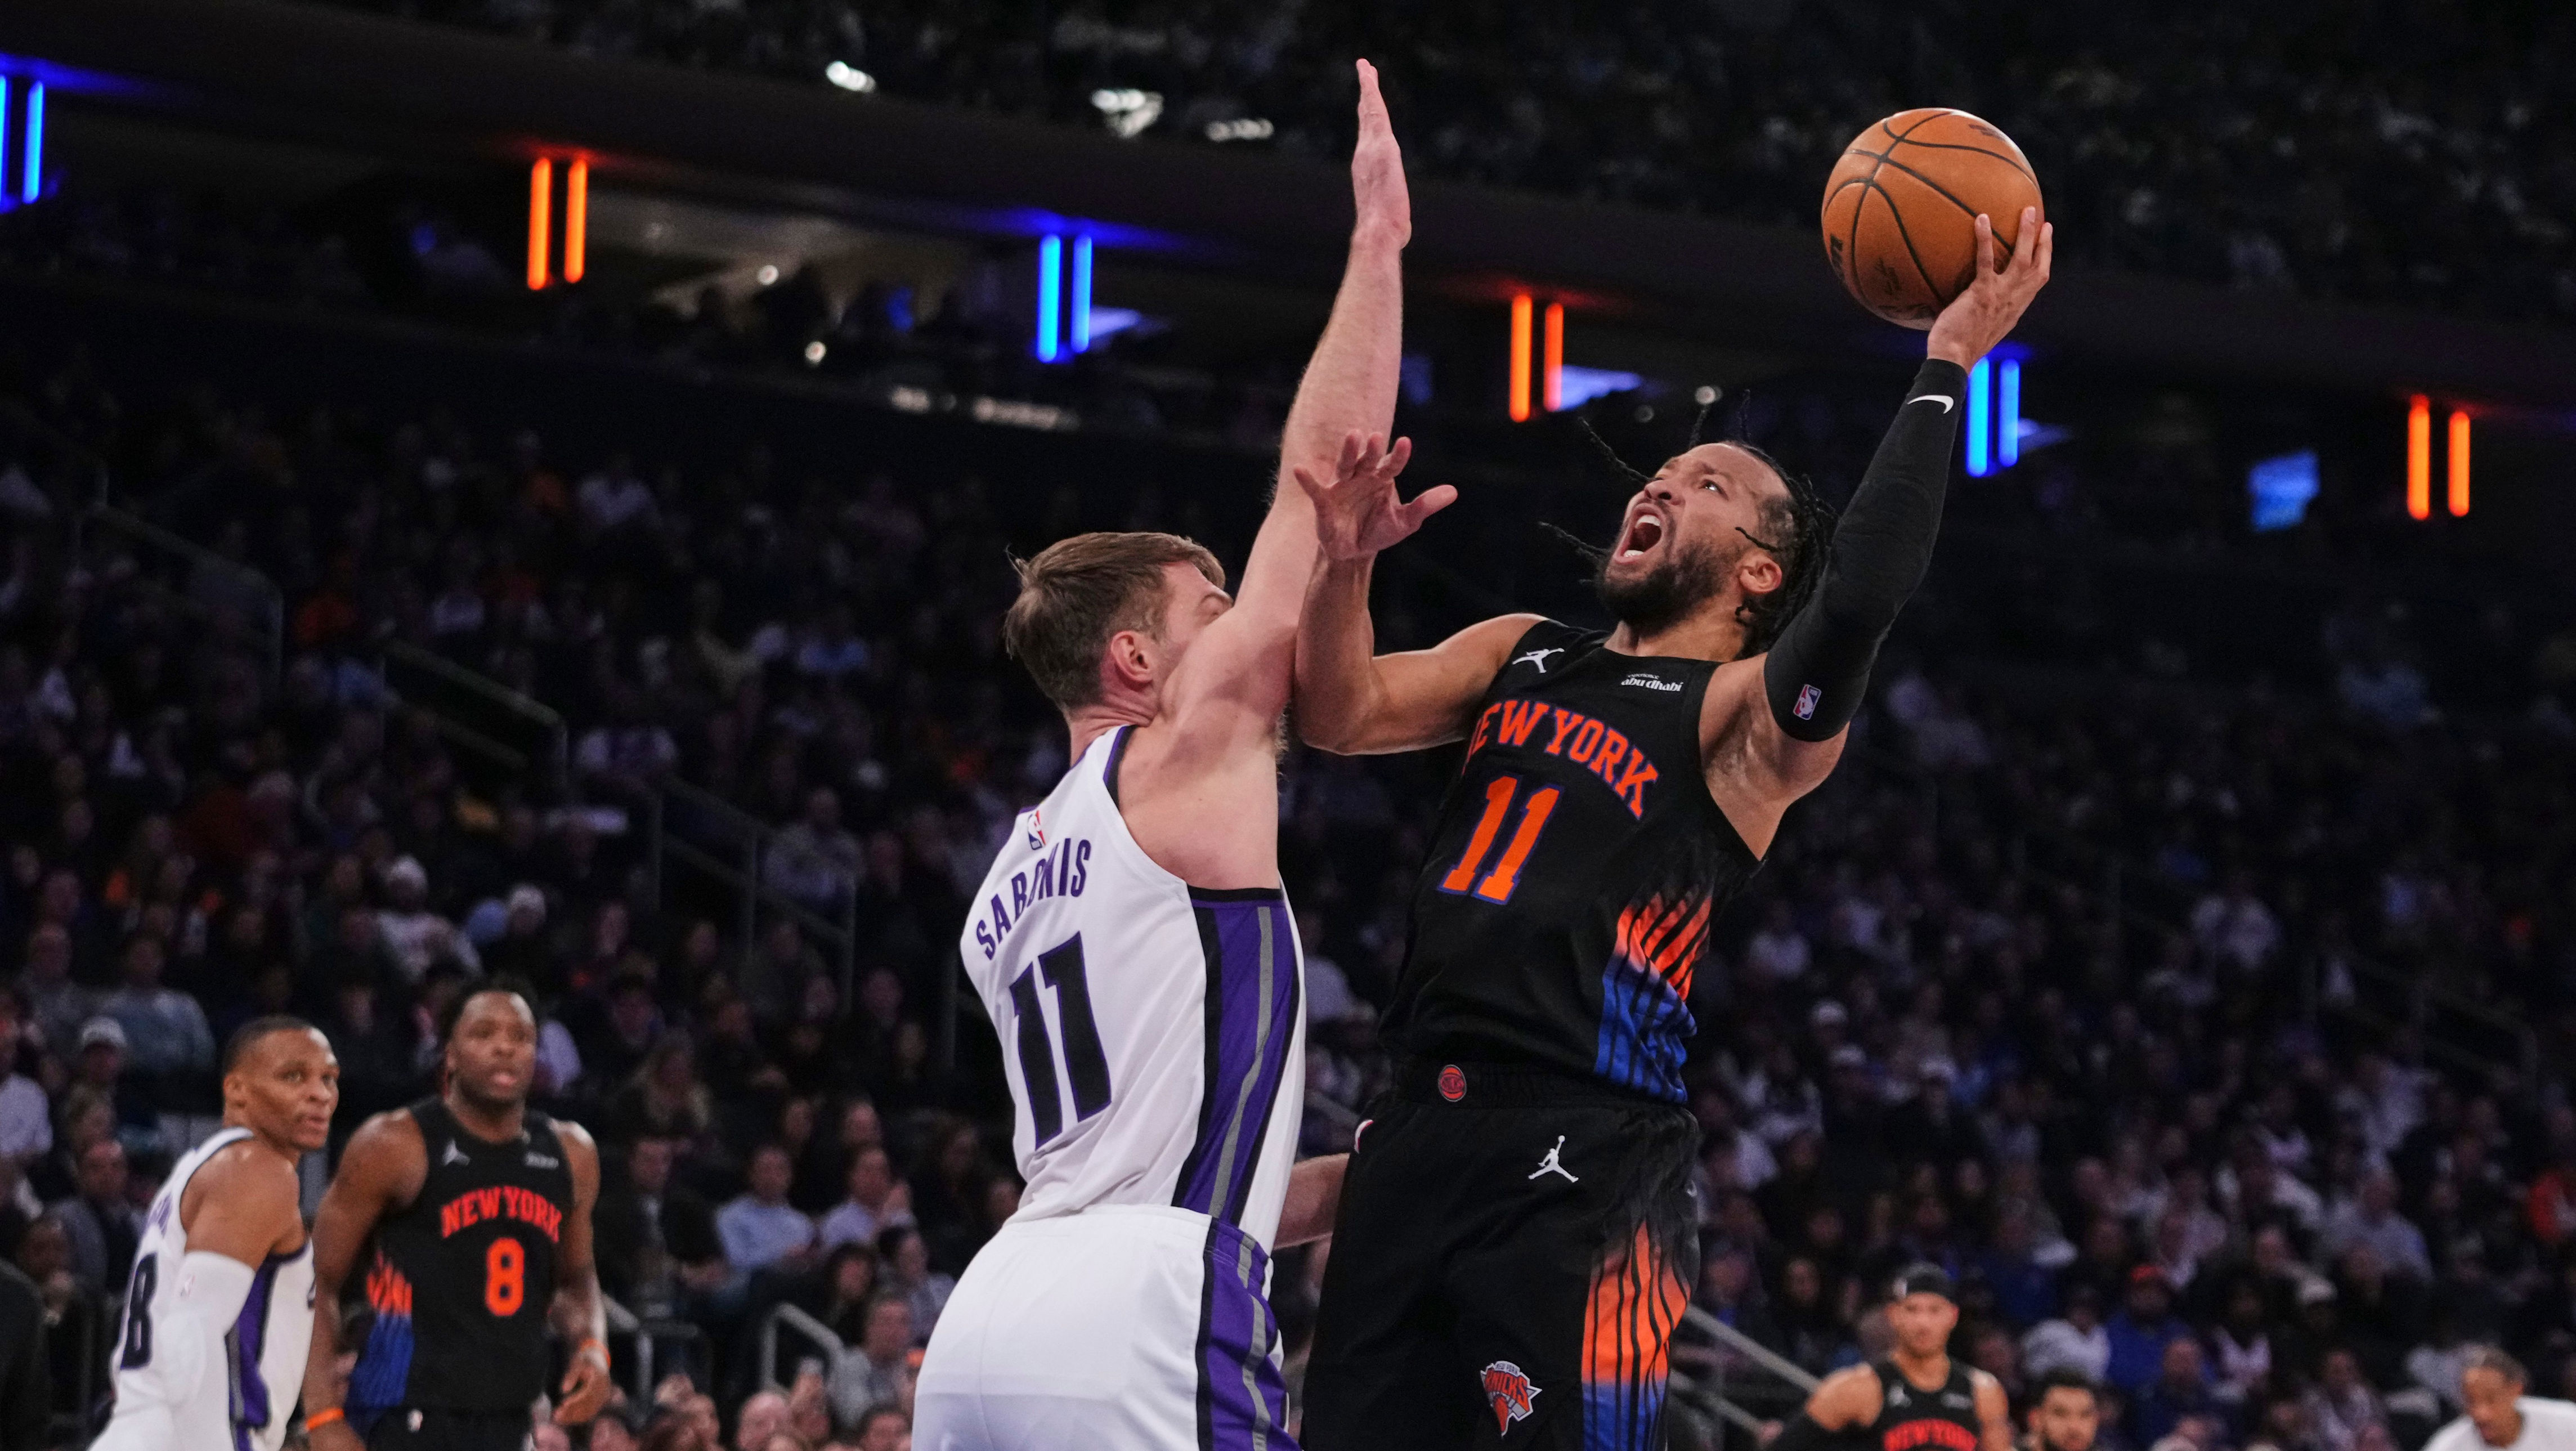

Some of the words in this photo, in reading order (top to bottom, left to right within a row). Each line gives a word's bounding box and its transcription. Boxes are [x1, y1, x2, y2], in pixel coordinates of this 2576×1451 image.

[1621, 678, 1646, 687] abu
[1645, 679, 1684, 692] dhabi
[1543, 707, 1661, 821] YORK
[1437, 773, 1564, 906] 11
[1009, 931, 1112, 1152] 11
[440, 1185, 503, 1239] NEW
[503, 1185, 562, 1244] YORK
[485, 1237, 525, 1318] 8
[1484, 1368, 1530, 1412] KNICKS
